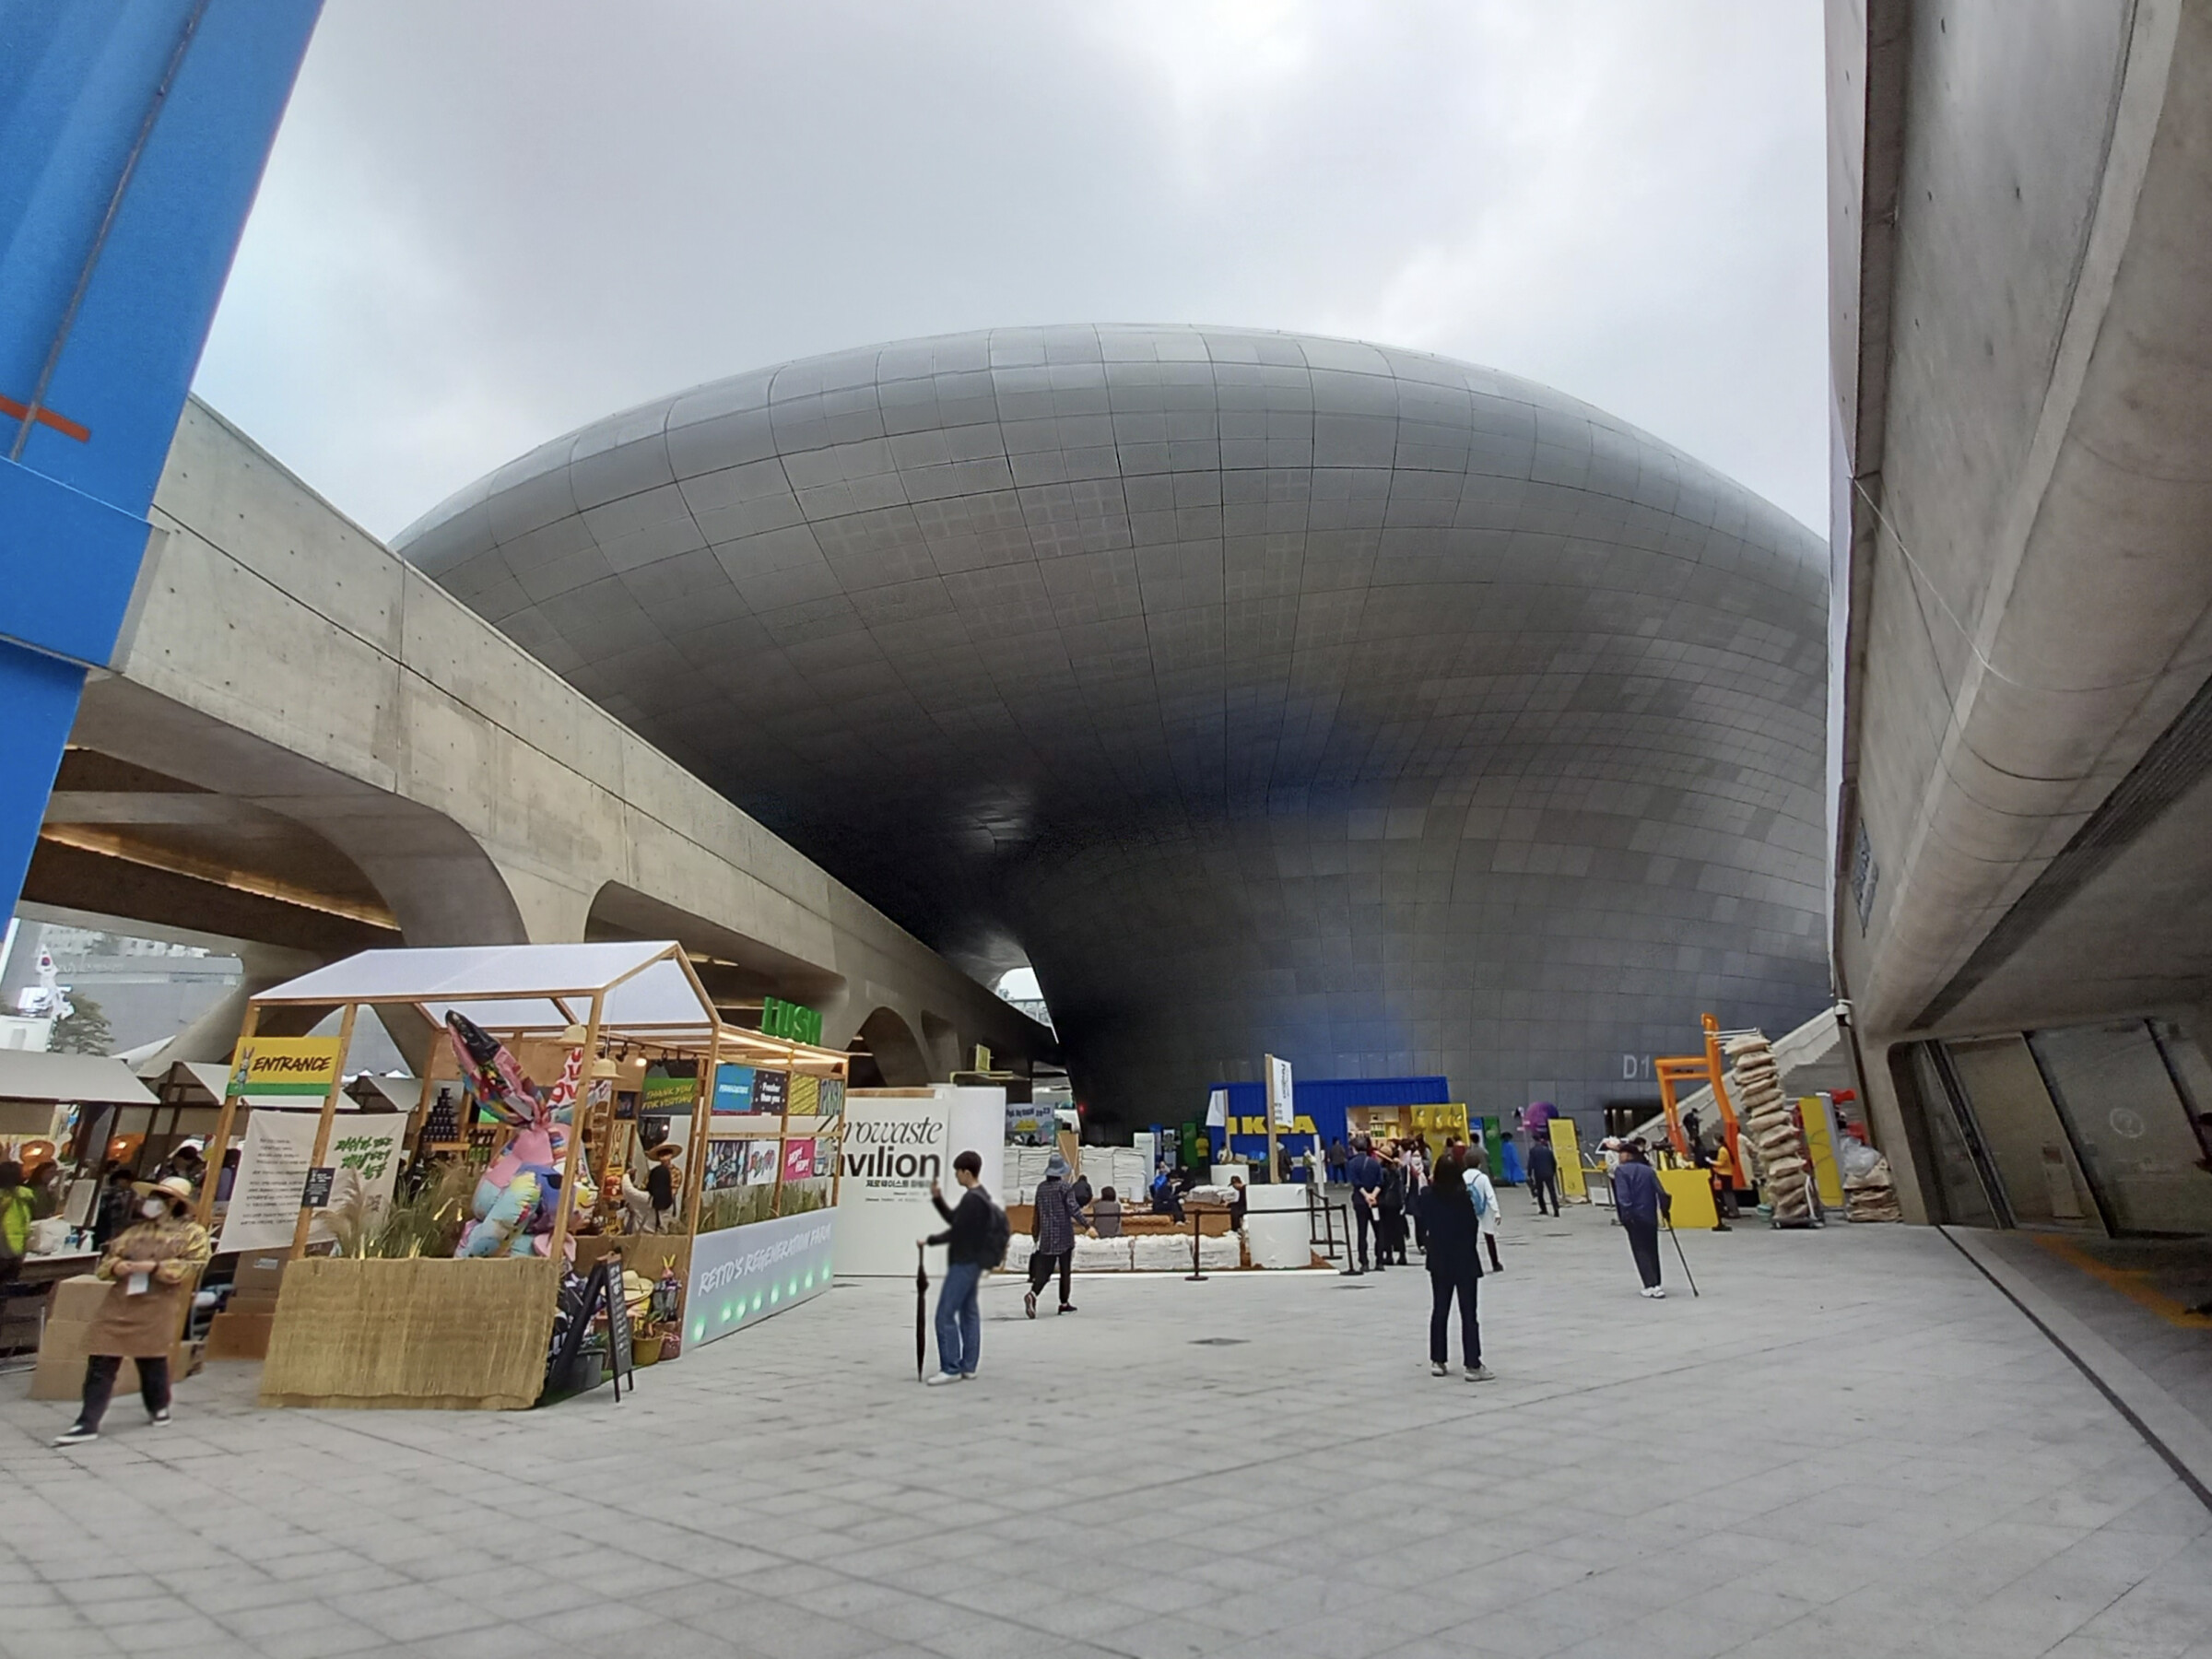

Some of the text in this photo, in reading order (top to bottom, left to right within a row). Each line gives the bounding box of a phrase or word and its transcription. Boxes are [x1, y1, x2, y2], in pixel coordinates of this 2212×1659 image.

[761, 996, 822, 1047] LUSH
[252, 1055, 332, 1073] ENTRANCE
[1623, 1054, 1650, 1079] D1
